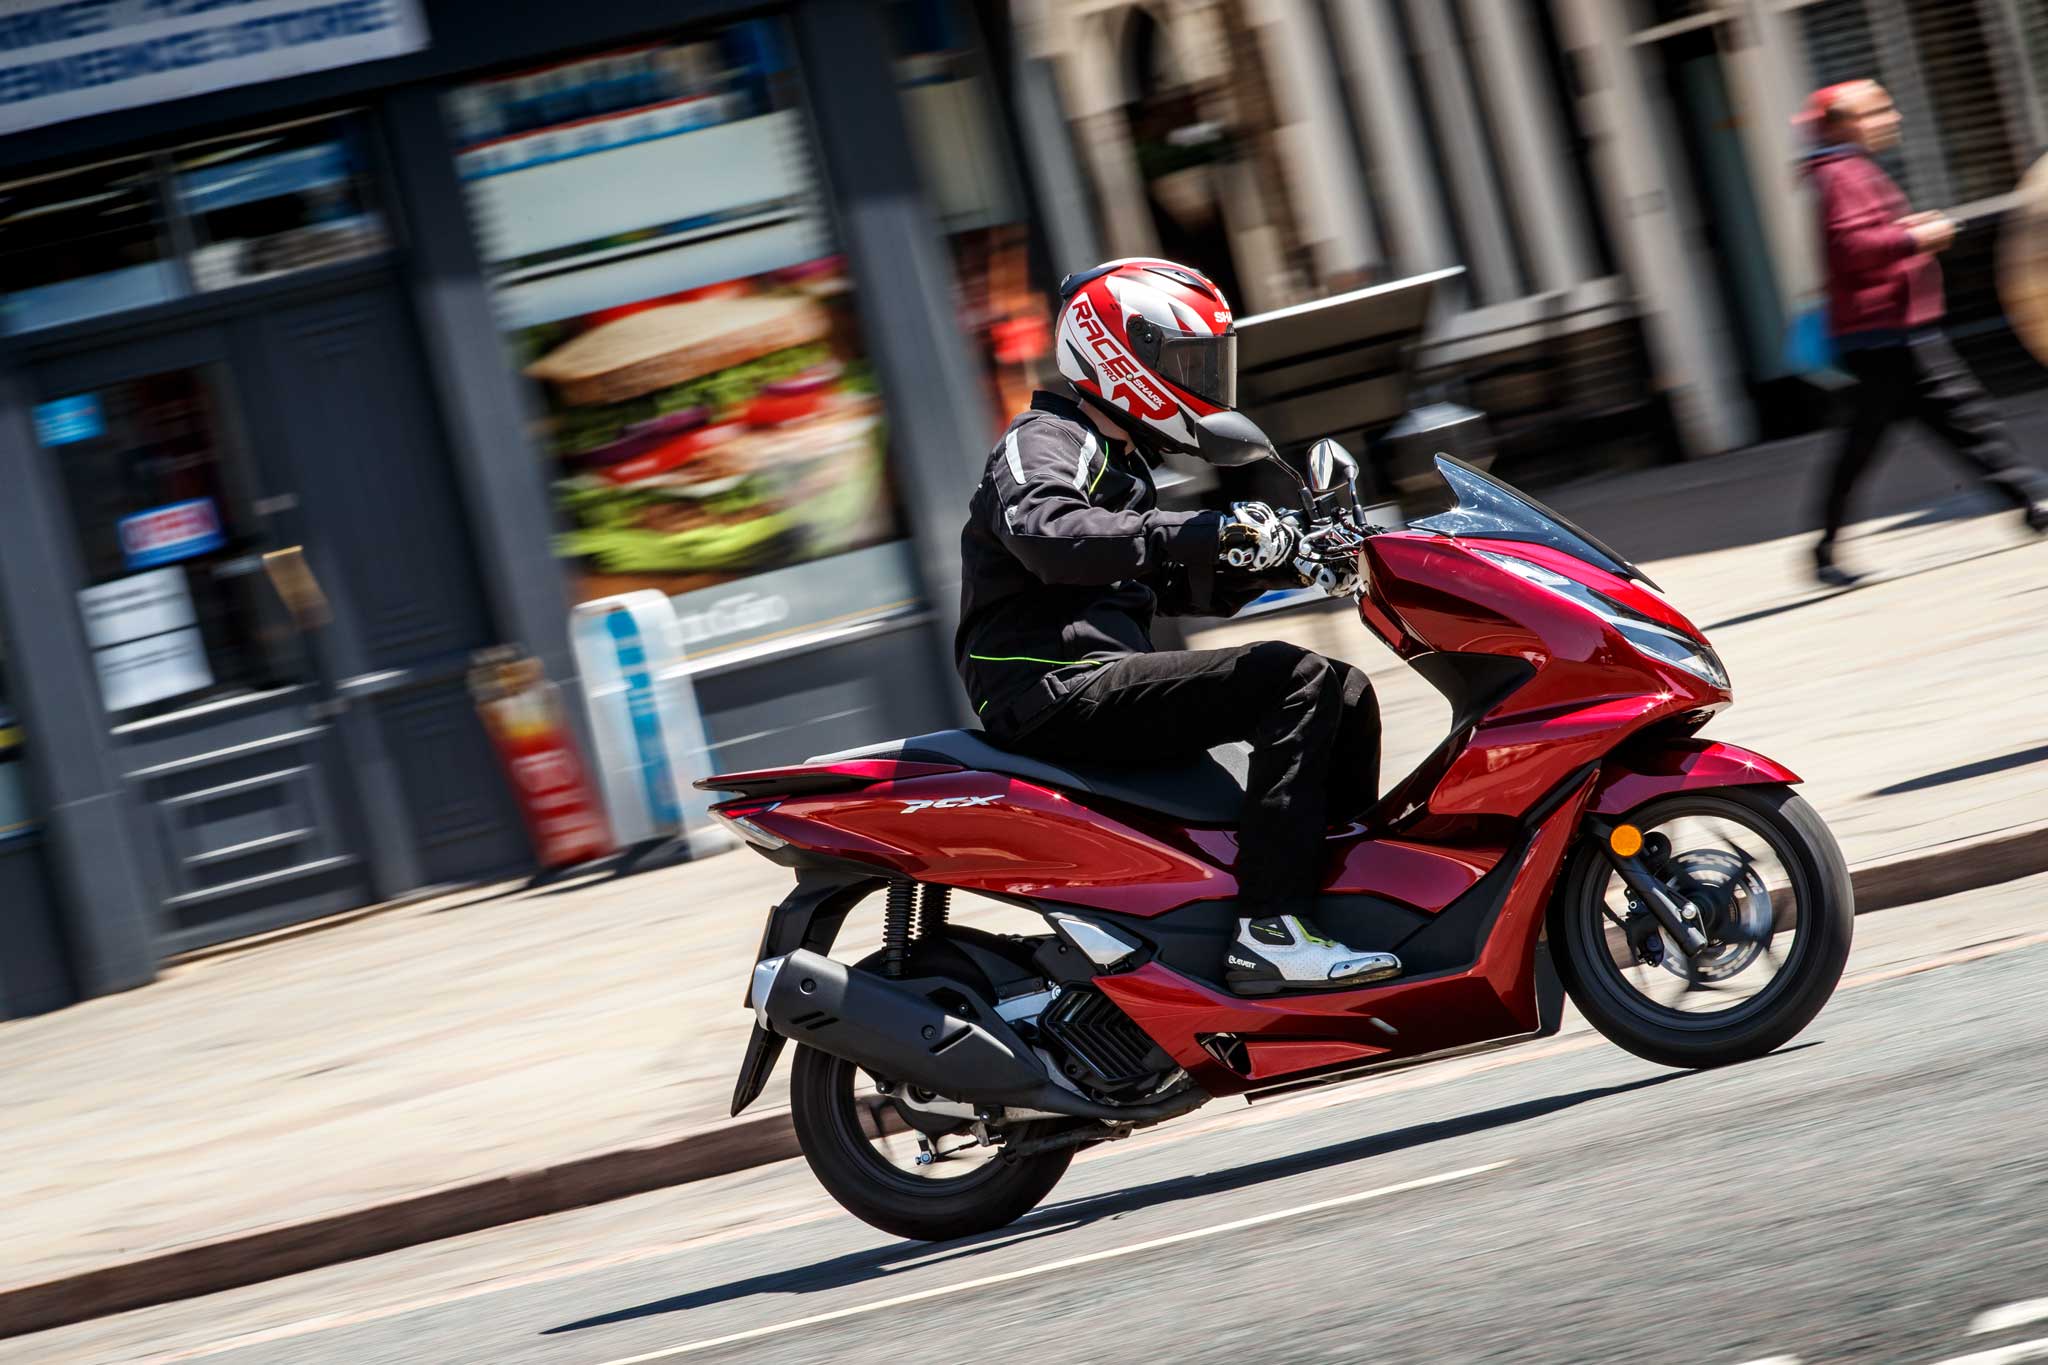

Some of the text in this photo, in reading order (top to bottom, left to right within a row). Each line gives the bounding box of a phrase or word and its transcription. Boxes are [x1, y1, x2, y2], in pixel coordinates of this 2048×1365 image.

[1072, 301, 1139, 379] RACE
[1098, 362, 1119, 382] PRO
[1132, 378, 1168, 408] SHARK
[900, 794, 1006, 814] PCX
